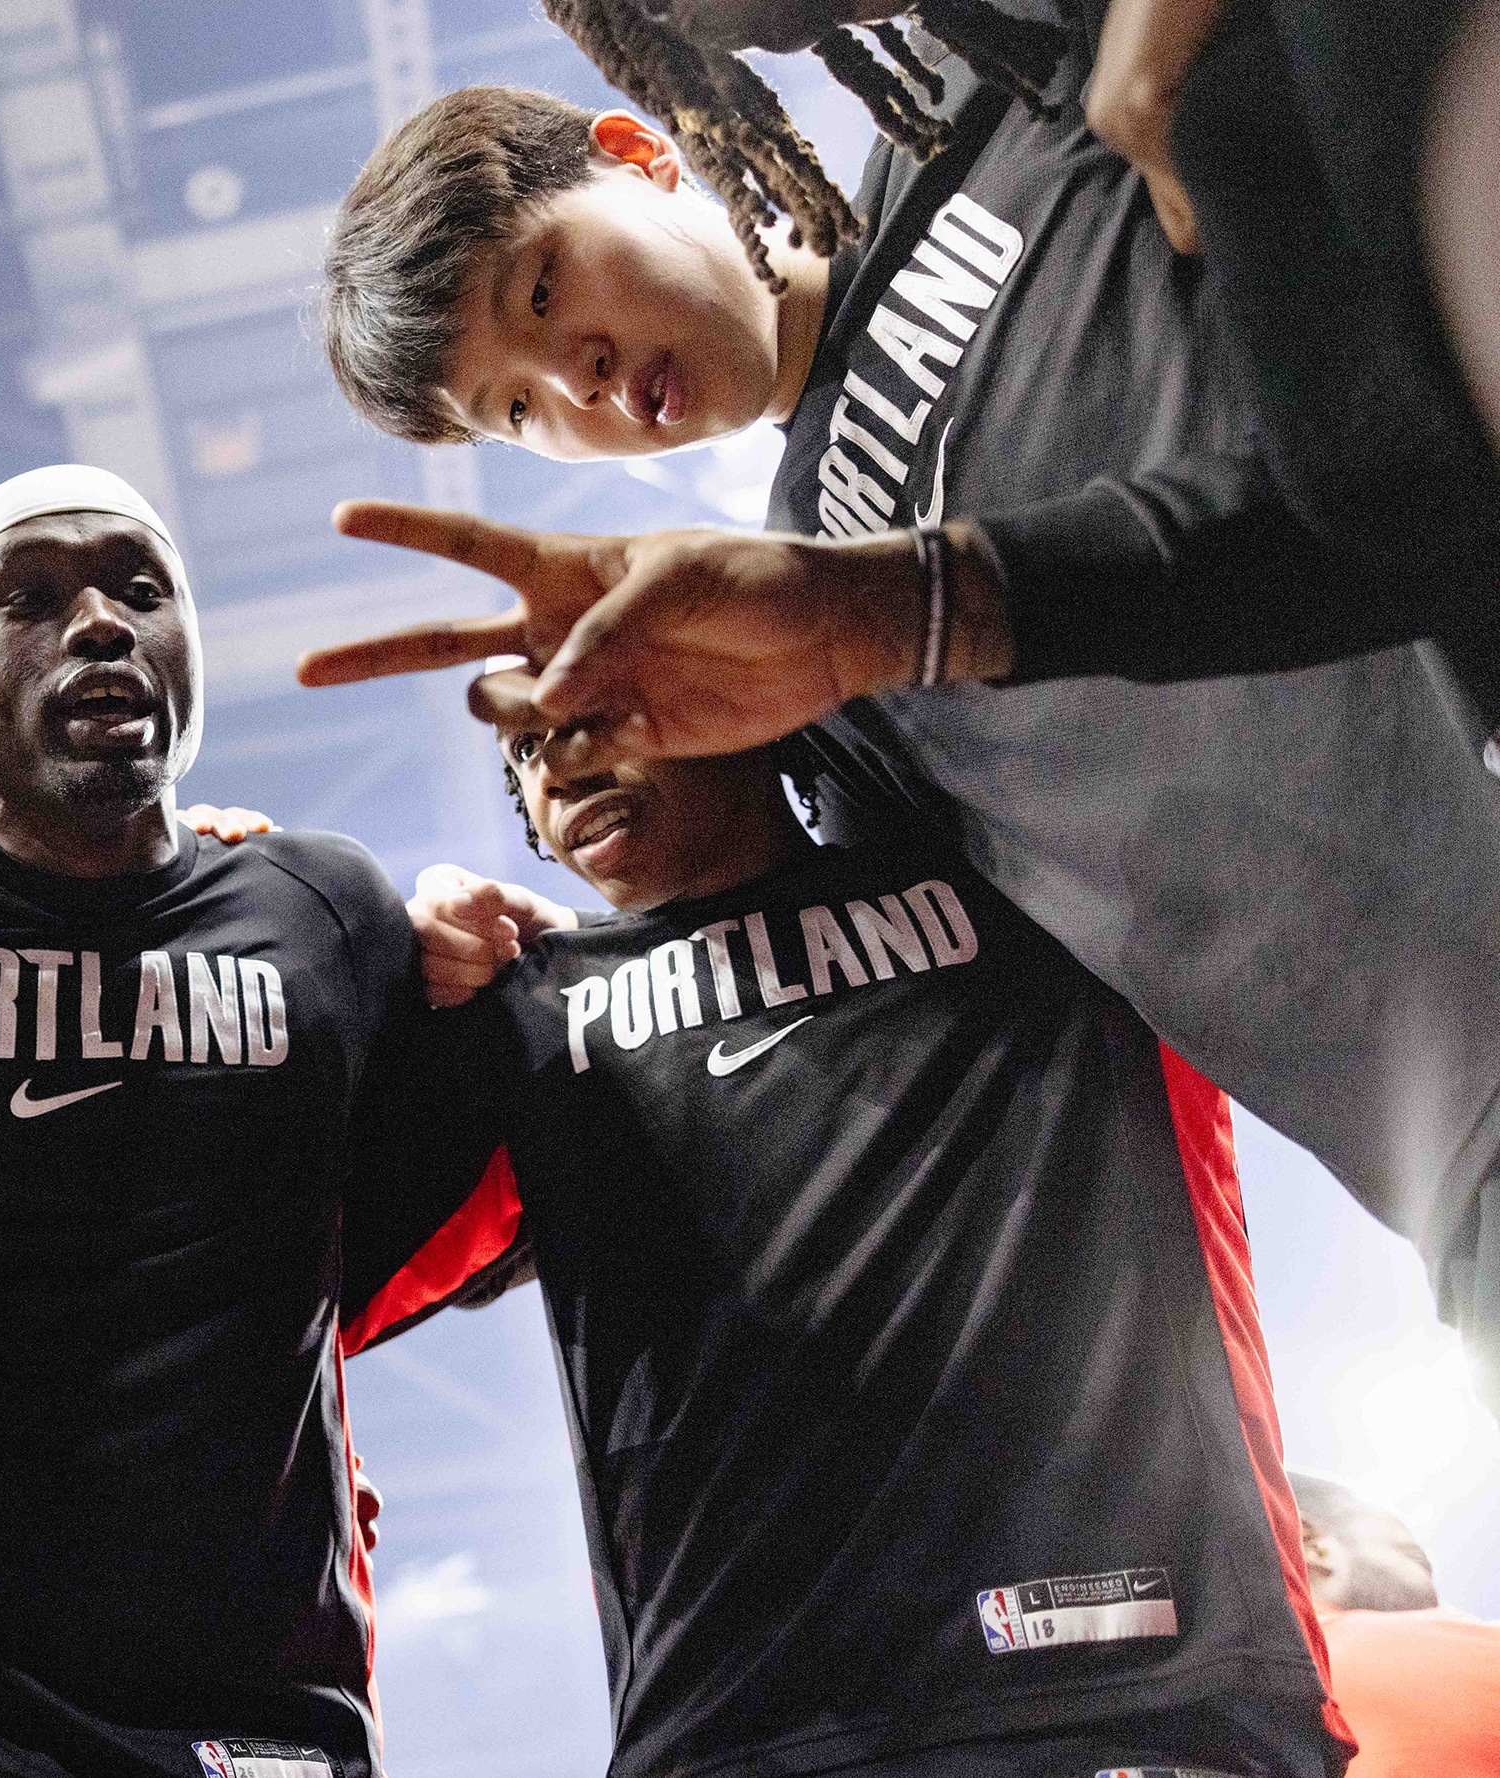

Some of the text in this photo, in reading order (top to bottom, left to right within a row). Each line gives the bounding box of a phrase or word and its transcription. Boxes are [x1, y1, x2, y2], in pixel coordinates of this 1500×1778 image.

[815, 193, 1024, 546] ORTLAND
[560, 880, 978, 1074] PORTLAND
[1029, 1591, 1040, 1605] L
[1031, 1618, 1056, 1640] 18
[229, 1743, 248, 1752] XL
